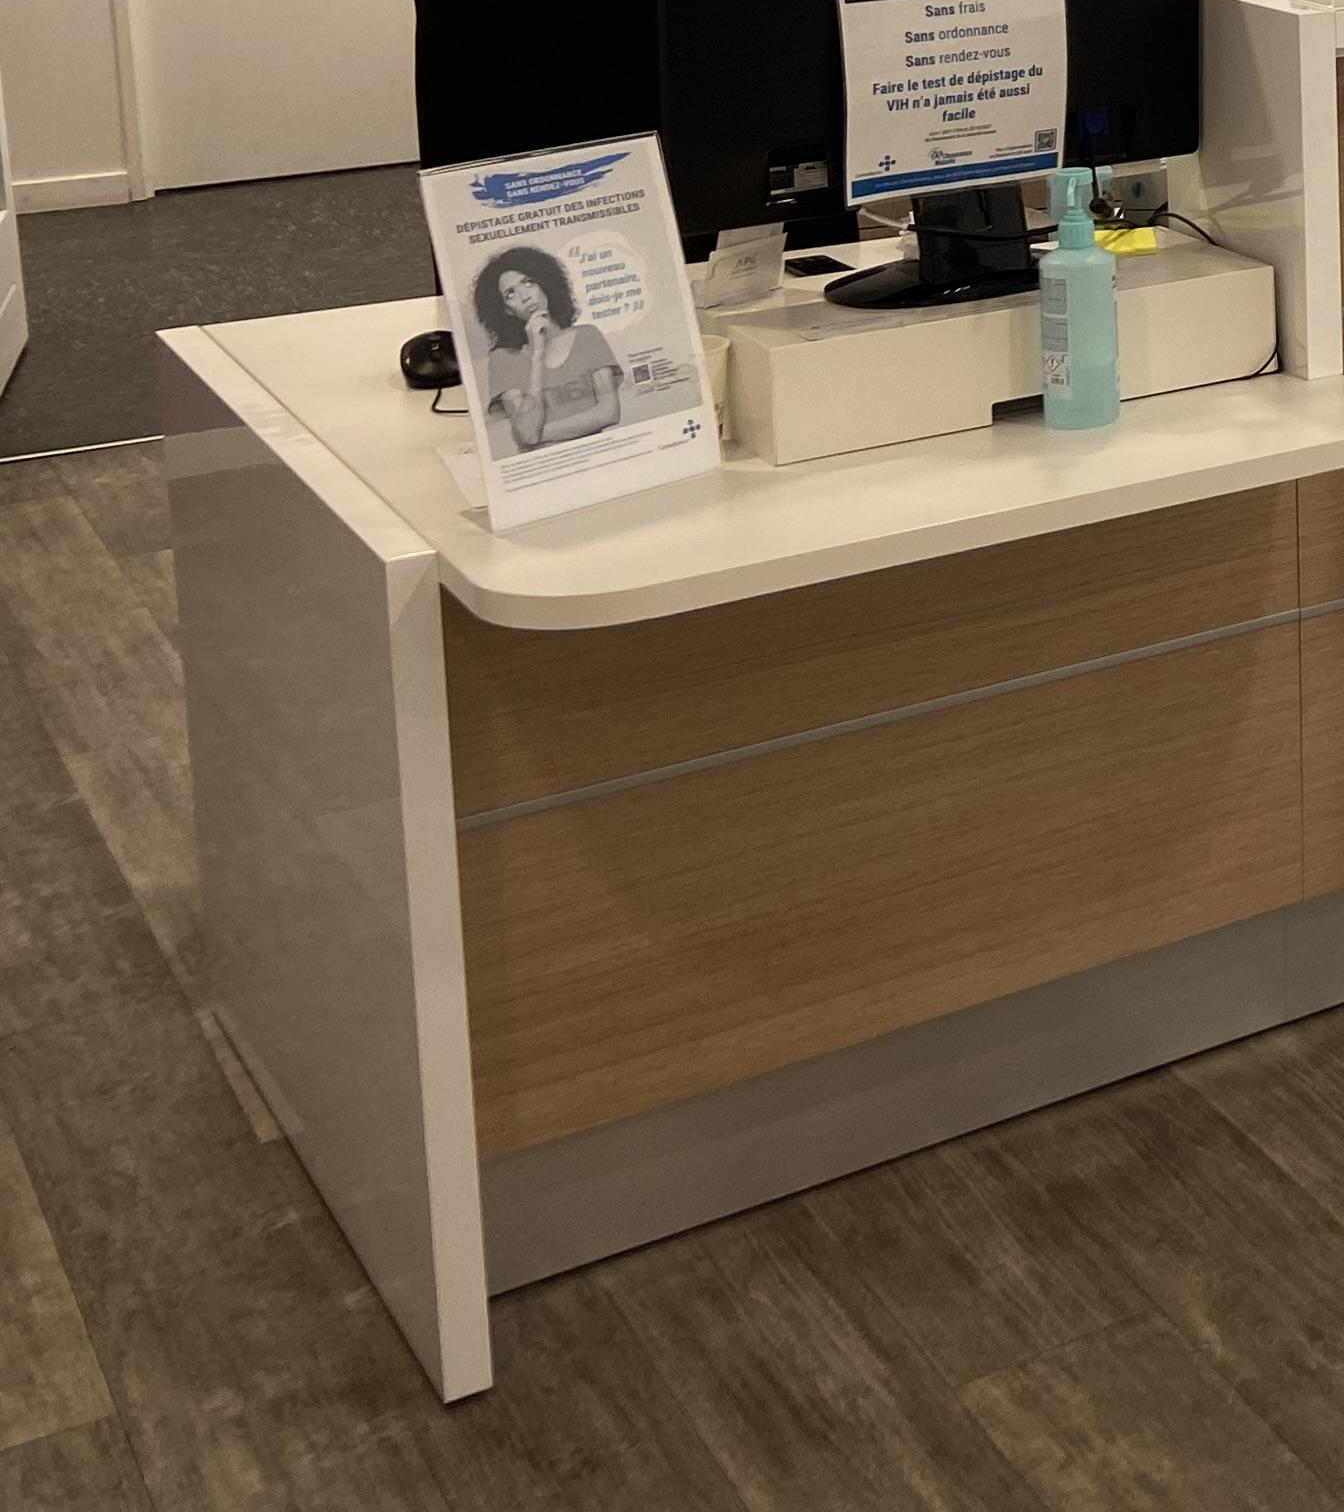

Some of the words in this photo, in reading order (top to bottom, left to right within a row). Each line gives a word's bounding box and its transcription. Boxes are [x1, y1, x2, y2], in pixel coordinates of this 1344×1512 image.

[925, 5, 955, 18] Sans
[959, 1, 986, 14] frais
[904, 31, 935, 44] Sans
[938, 23, 1009, 40] ordonnance
[905, 55, 936, 68] Sans
[939, 46, 1011, 64] rendez-vous
[873, 81, 904, 96] Faire
[907, 79, 919, 92] le
[922, 77, 946, 90] test
[949, 73, 964, 86] de
[967, 67, 1026, 85] dépistage
[1028, 64, 1043, 77] du
[886, 98, 909, 112] VIH
[912, 96, 931, 109] n'a
[934, 89, 974, 109] jamais
[977, 87, 996, 100] été
[999, 83, 1031, 98] aussi
[942, 108, 976, 123] facile
[504, 179, 528, 190] SANS
[528, 169, 583, 186] ORDONNANCE
[506, 187, 529, 198] SANS
[529, 176, 585, 194] RENDEZ-VOUS
[456, 212, 515, 235] DÉPISTAGE
[518, 205, 563, 222] GRATUIT
[564, 201, 584, 213] DES
[586, 189, 646, 209] INFECTIONS
[468, 221, 551, 245] SEXUELLEMENT
[553, 203, 640, 227] TRANSMISSIBLES
[600, 250, 613, 259] un
[582, 261, 626, 278] nouveau
[589, 291, 624, 306] dois-je
[626, 287, 642, 297] me
[592, 307, 621, 320] tester
